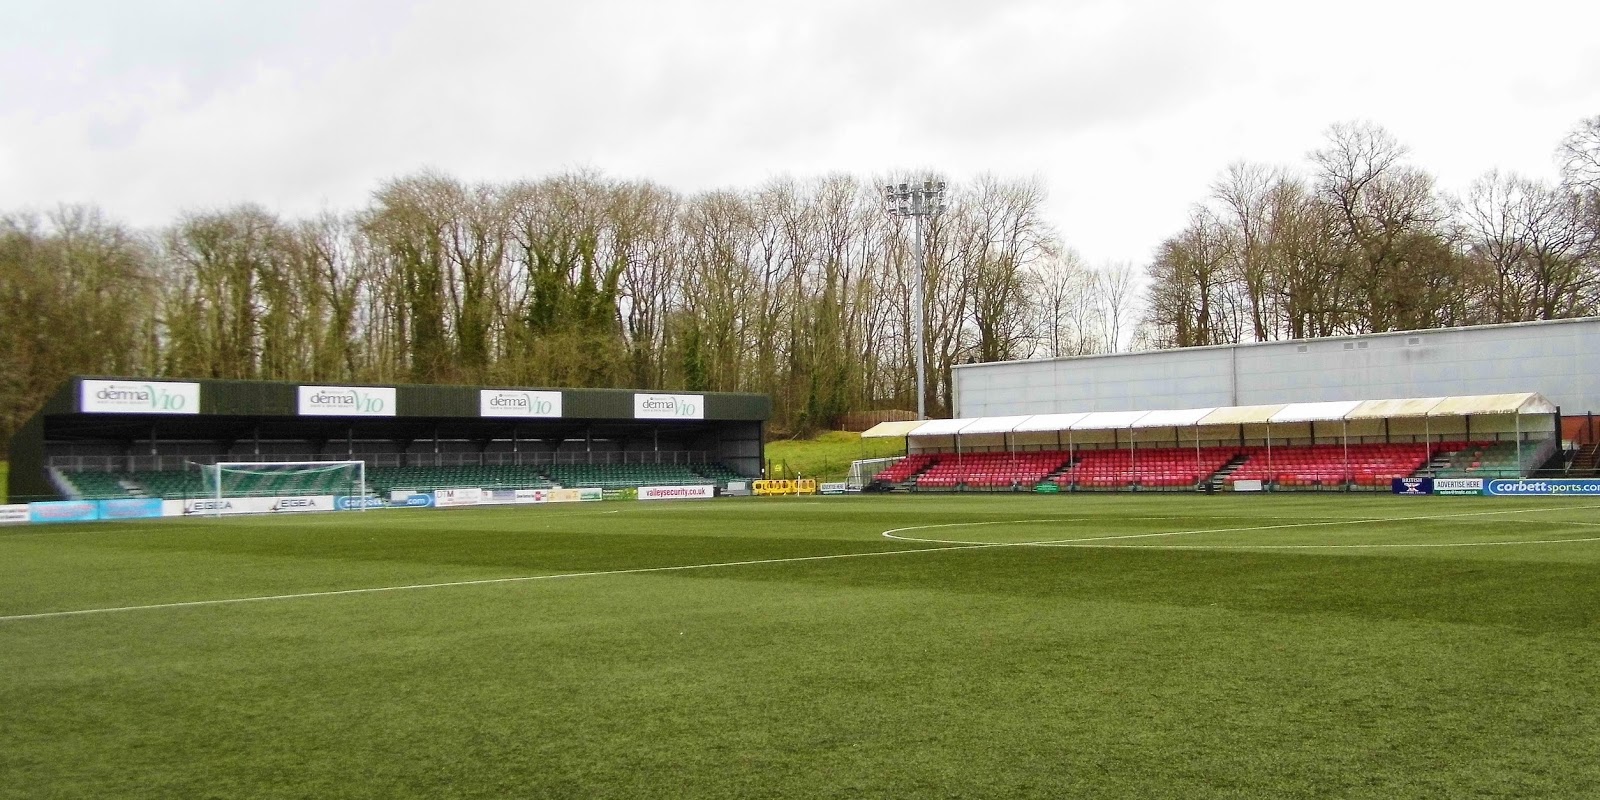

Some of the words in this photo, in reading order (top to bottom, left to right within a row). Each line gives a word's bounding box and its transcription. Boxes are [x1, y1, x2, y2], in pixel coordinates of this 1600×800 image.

[97, 388, 149, 401] derma
[310, 393, 354, 404] derma
[490, 396, 526, 406] derma
[642, 400, 674, 409] derma
[437, 490, 454, 498] DTM
[646, 488, 706, 498] valleysecurity.co.uk
[280, 499, 316, 507] EGEA
